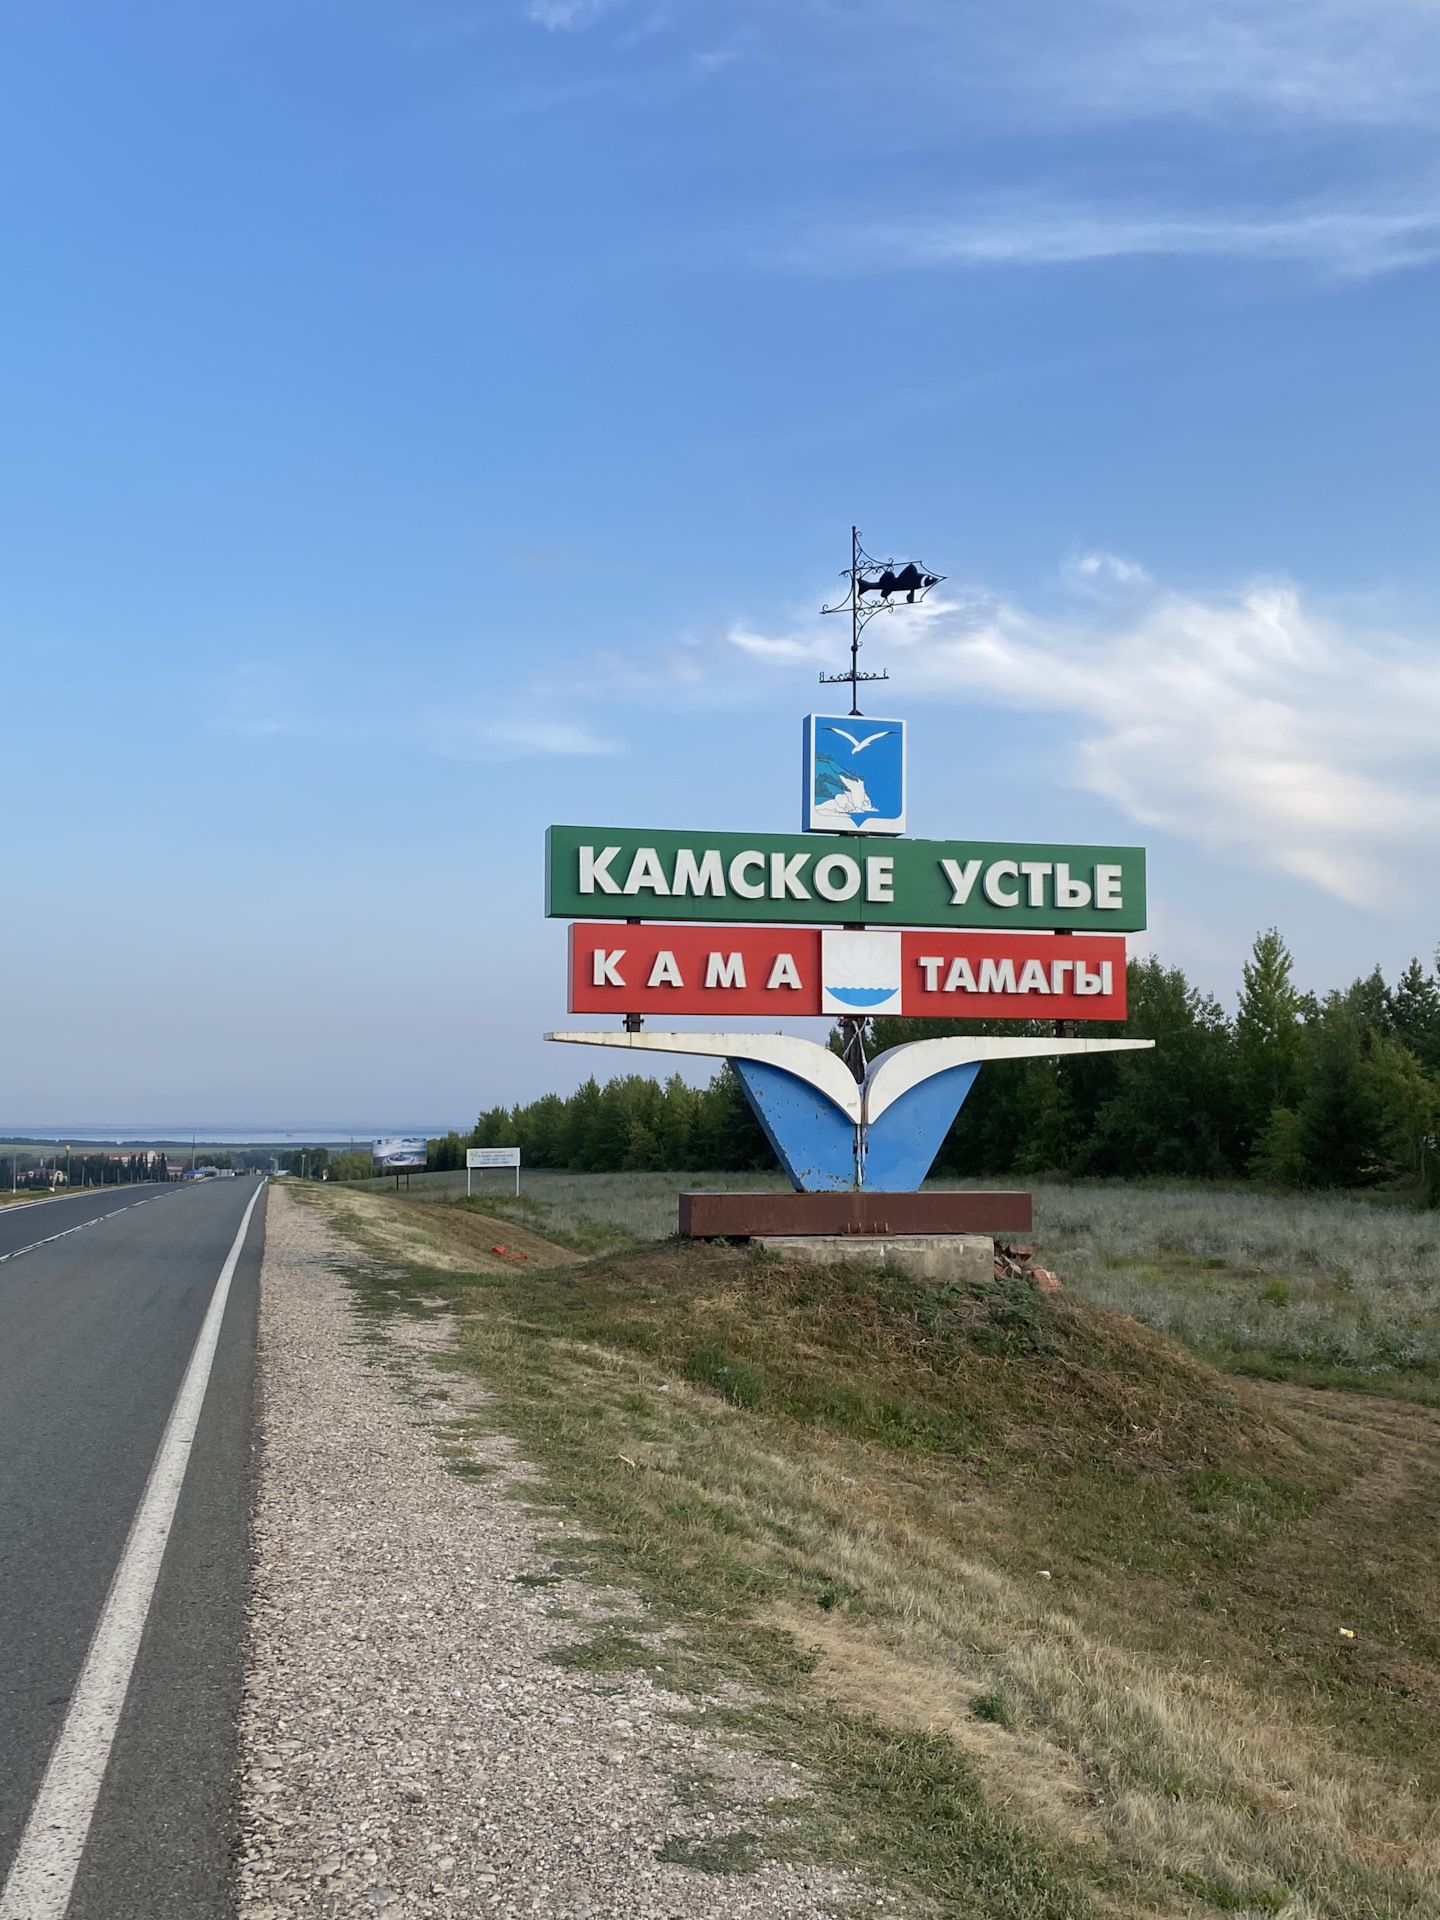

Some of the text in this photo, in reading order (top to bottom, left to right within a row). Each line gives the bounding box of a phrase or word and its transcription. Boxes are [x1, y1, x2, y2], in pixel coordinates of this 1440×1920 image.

[578, 846, 1123, 909] КАМСКОЕ УСТЬЕ
[592, 948, 1113, 995] КАМА ТАМАГЫ
